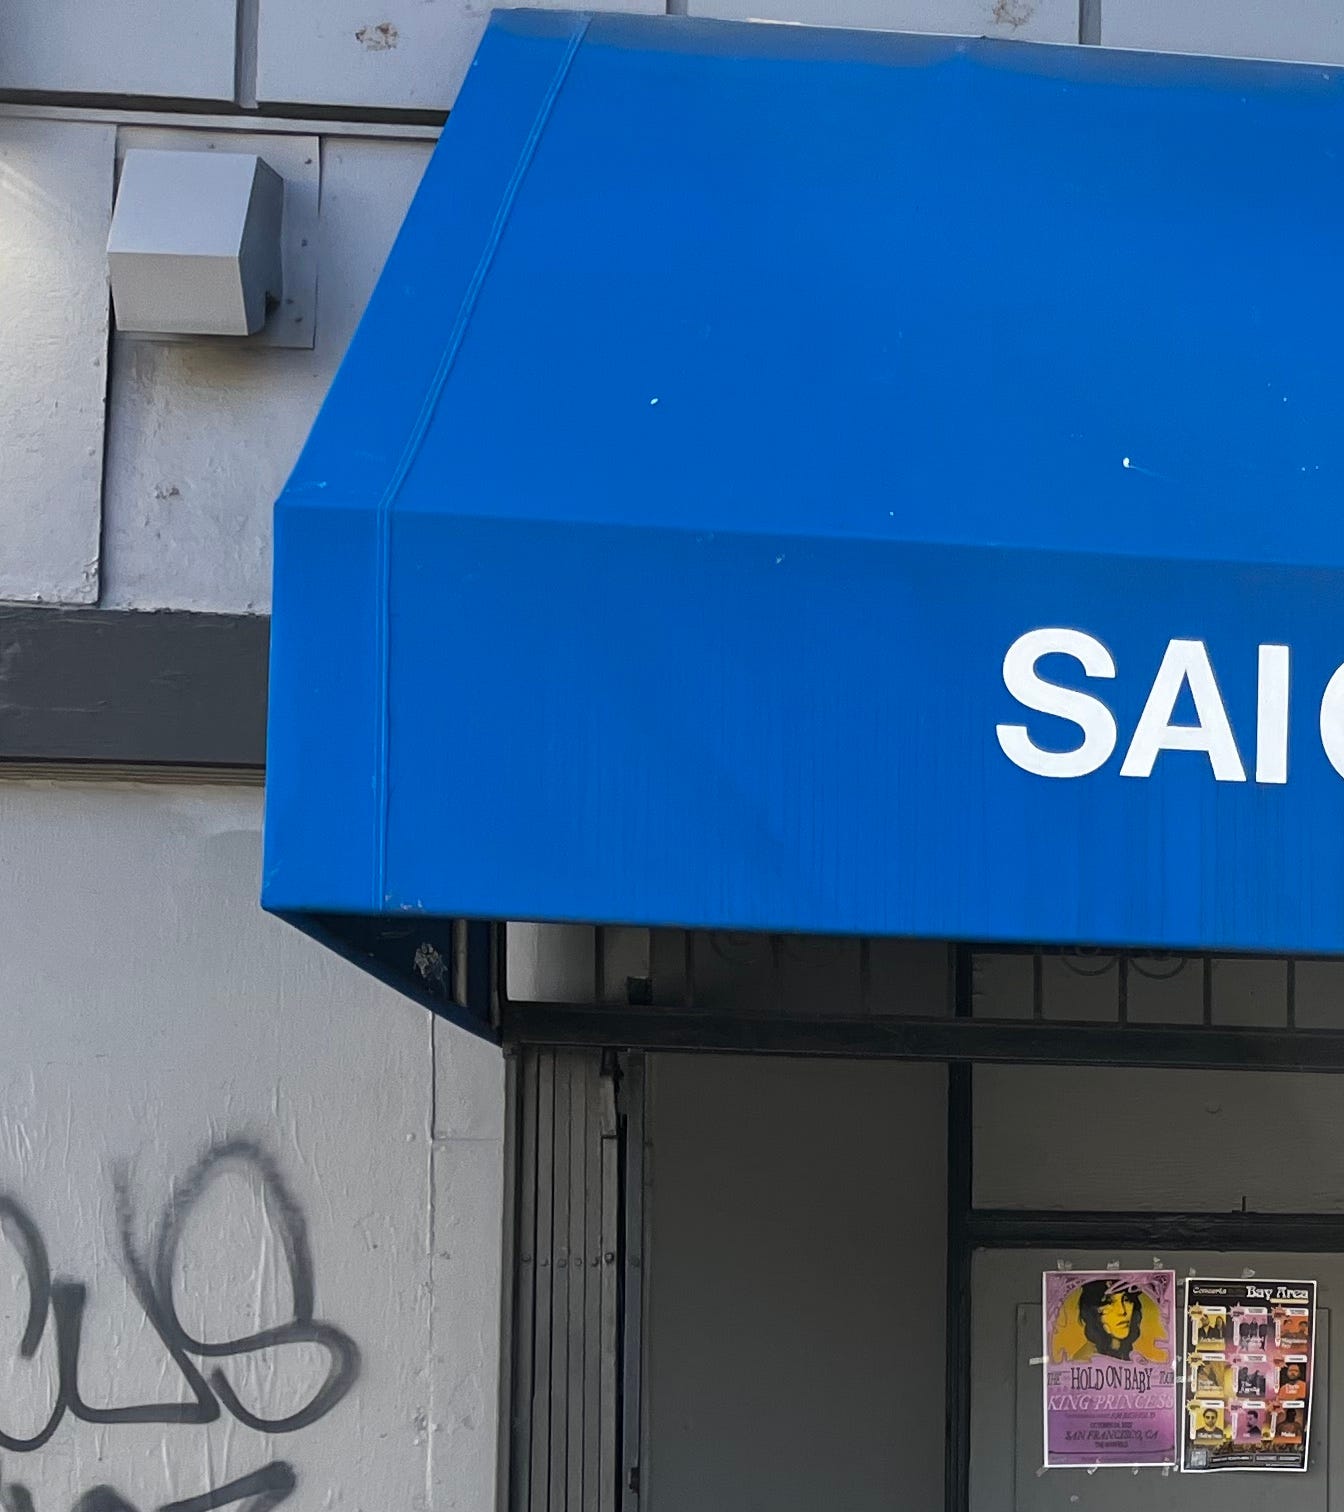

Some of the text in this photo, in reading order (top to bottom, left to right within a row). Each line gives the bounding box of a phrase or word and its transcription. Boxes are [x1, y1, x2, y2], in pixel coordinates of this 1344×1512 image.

[1246, 1285, 1272, 1300] Bay
[1277, 1286, 1308, 1299] Area
[1071, 1367, 1104, 1390] HOLD
[1106, 1365, 1122, 1389] ON
[1124, 1366, 1153, 1393] BABY
[1048, 1393, 1174, 1410] KING PRINCESS
[1065, 1430, 1085, 1440] SAN
